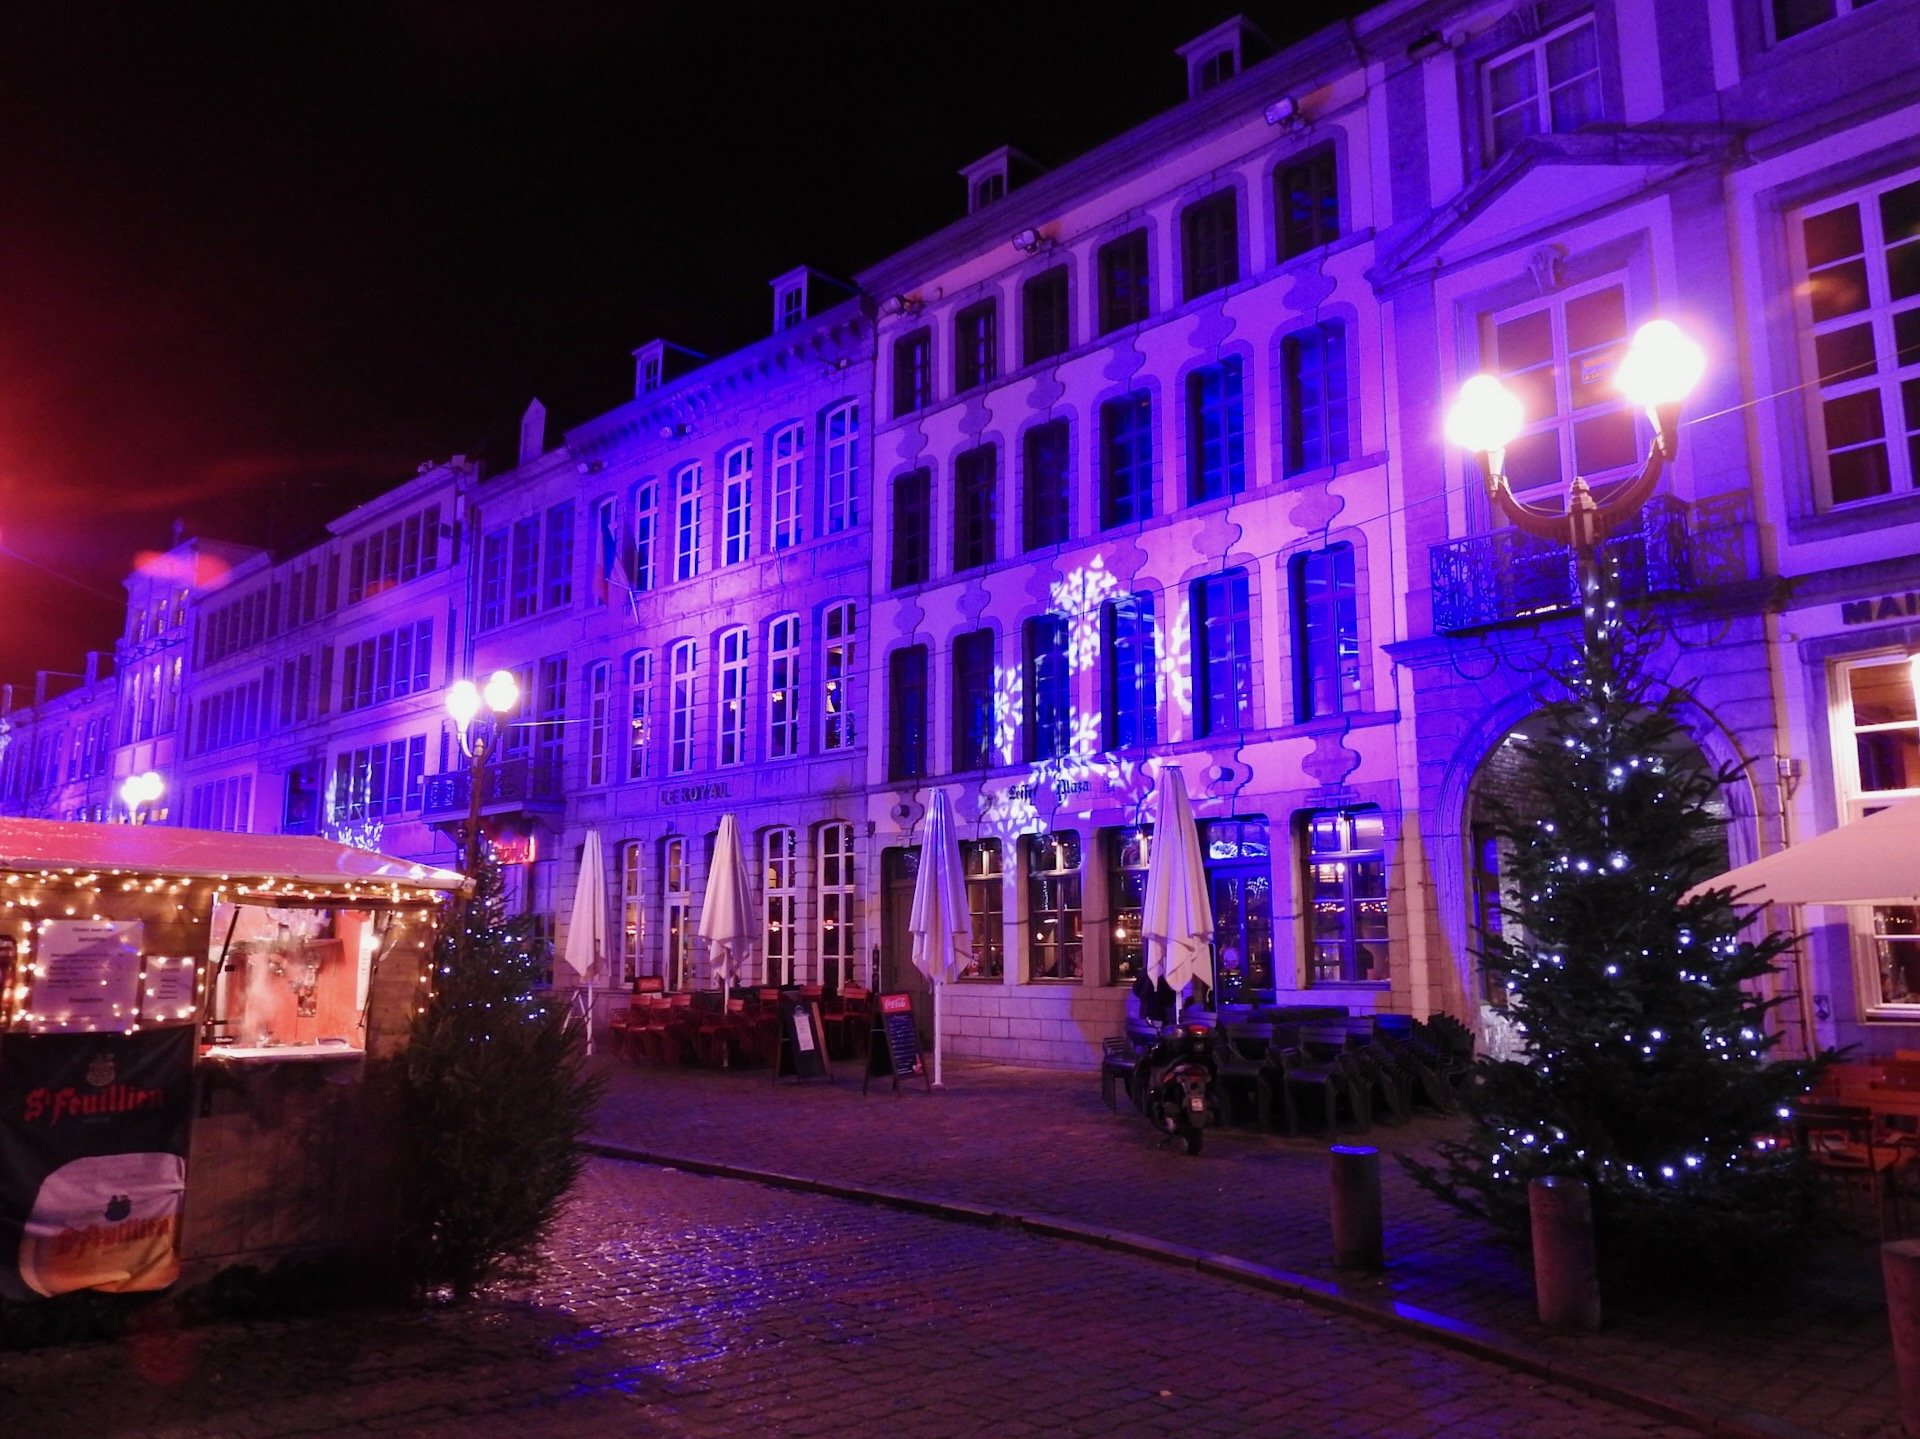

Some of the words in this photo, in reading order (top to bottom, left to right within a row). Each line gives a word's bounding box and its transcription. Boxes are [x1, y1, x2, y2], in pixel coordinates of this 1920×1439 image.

[1841, 592, 1920, 626] MAI
[661, 788, 681, 806] LE
[681, 782, 732, 801] ROYAL
[1055, 779, 1090, 803] Plaza
